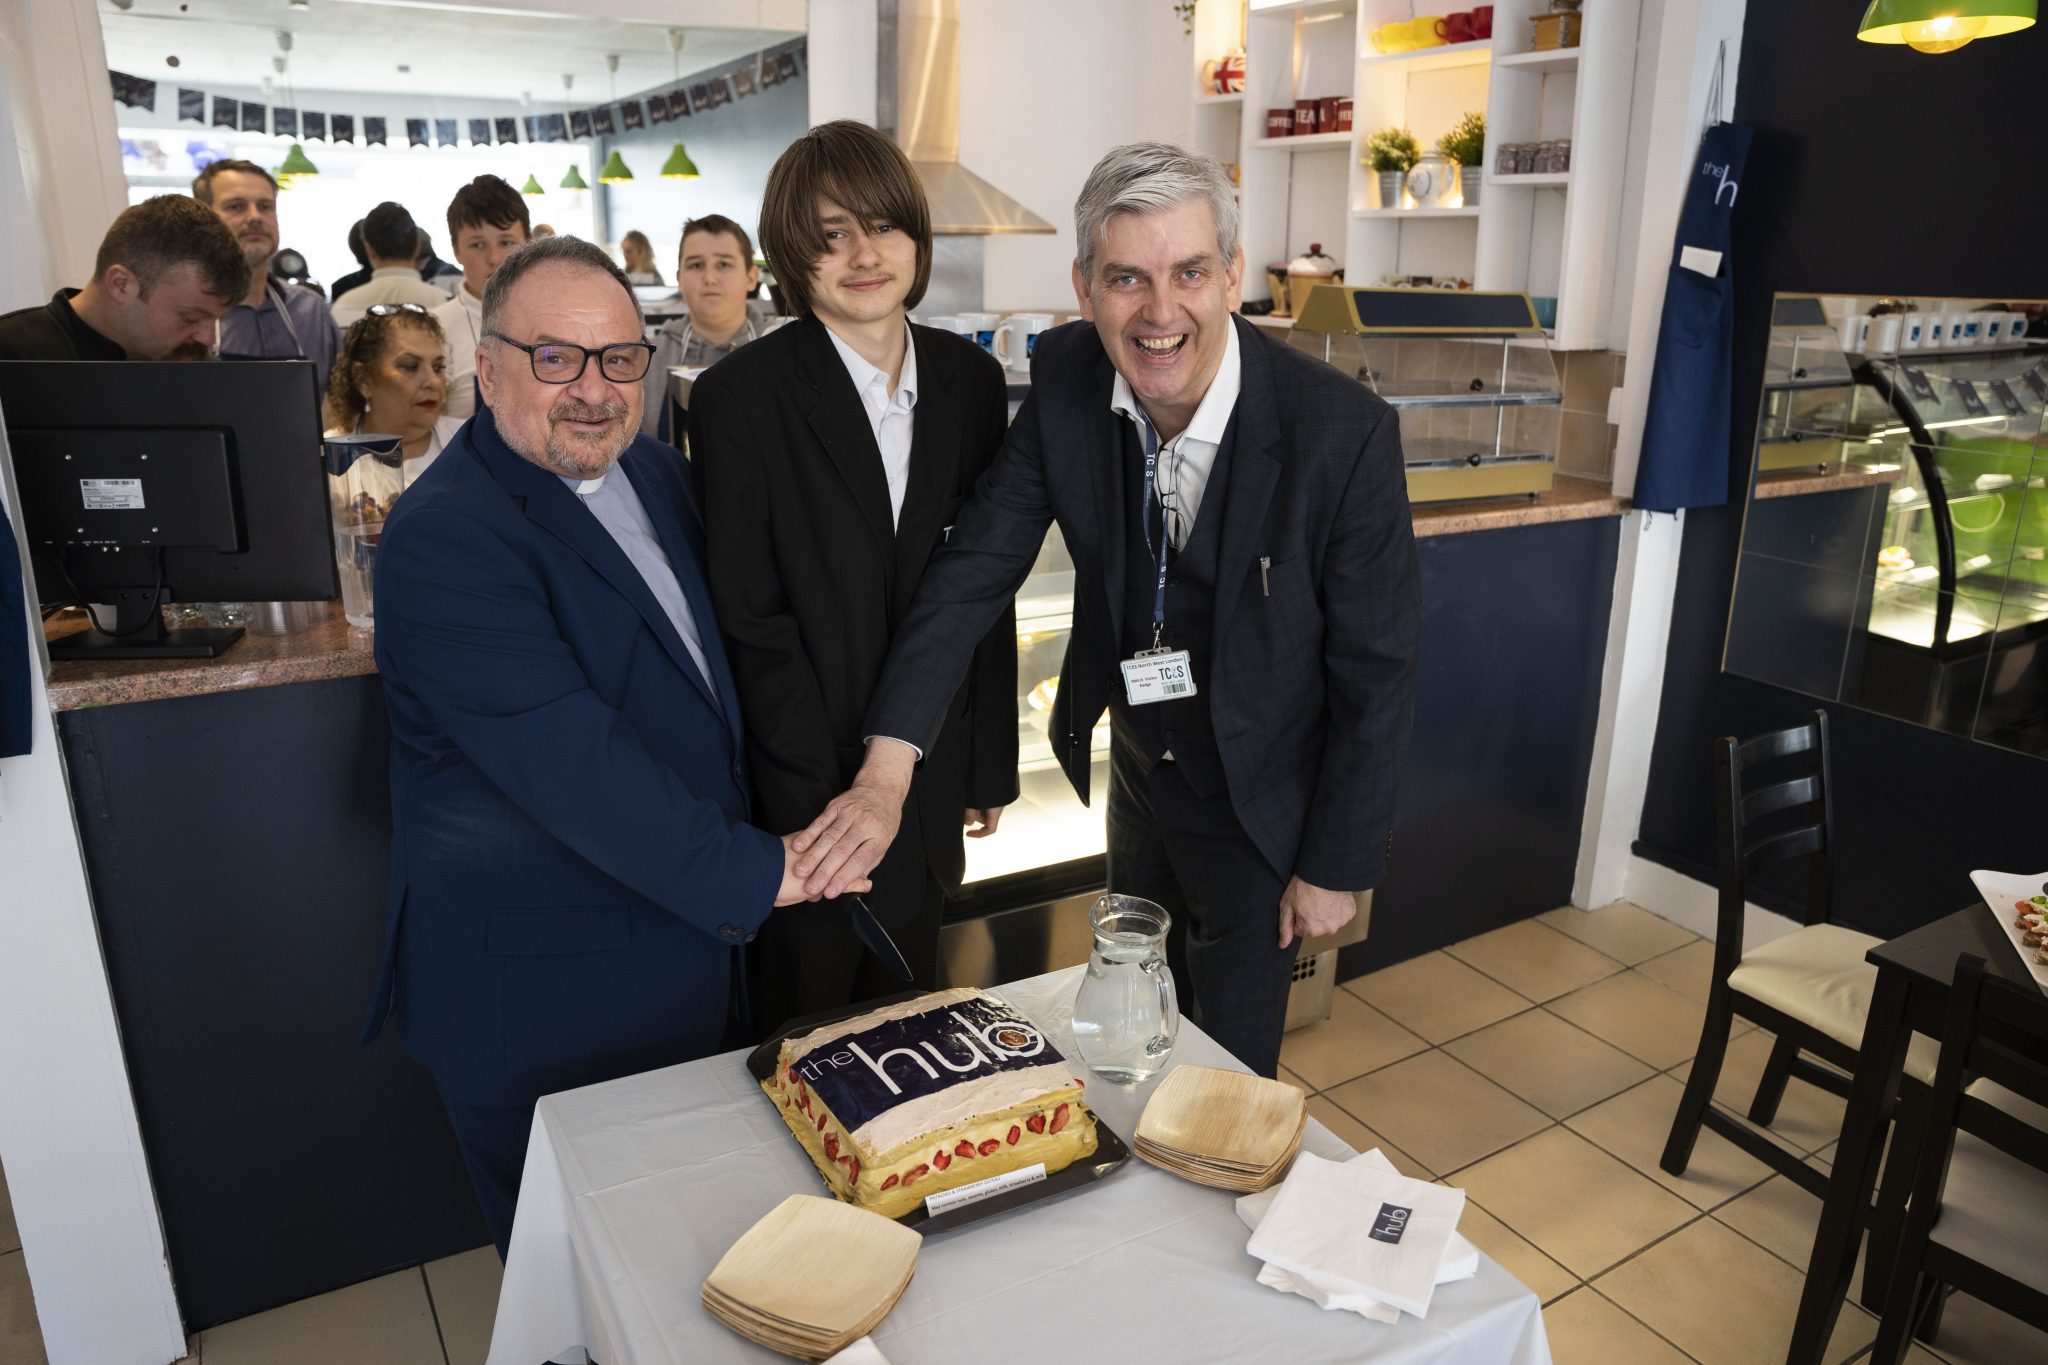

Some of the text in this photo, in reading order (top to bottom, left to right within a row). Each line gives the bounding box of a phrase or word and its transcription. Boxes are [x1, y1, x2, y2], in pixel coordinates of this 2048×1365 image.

[1702, 161, 1724, 178] the
[801, 1011, 1045, 1095] the hub
[983, 1176, 1000, 1184] GATEAU
[1008, 1177, 1030, 1187] strawberry
[1375, 1209, 1407, 1236] hub
